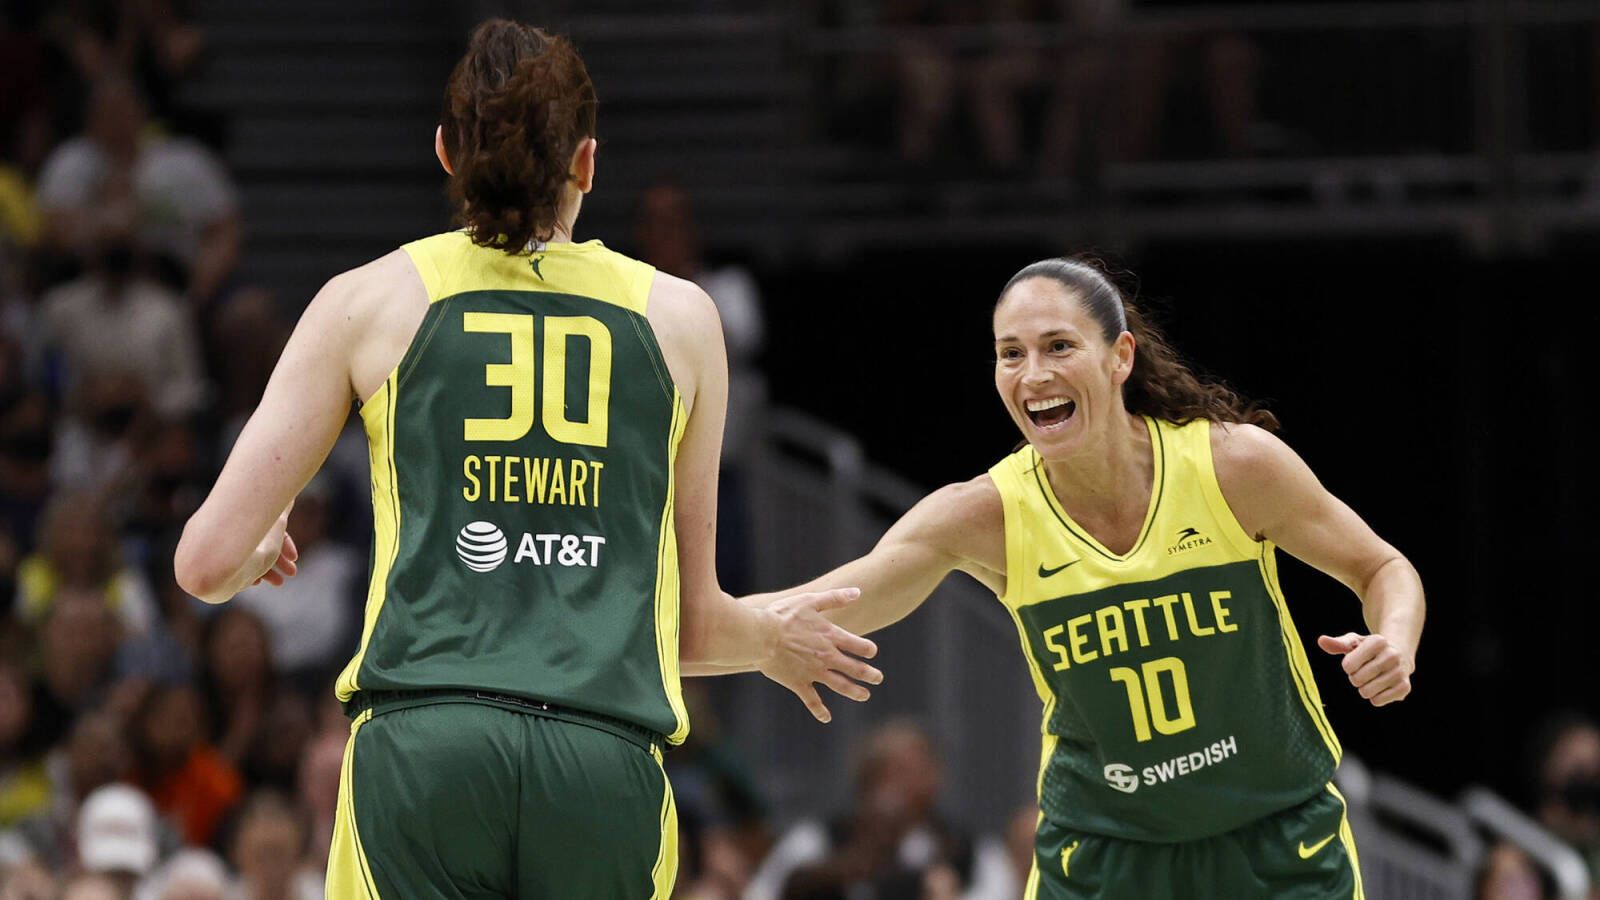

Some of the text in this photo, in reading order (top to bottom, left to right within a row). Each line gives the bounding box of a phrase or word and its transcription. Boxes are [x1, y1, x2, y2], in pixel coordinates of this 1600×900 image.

[463, 312, 612, 448] 30
[463, 454, 604, 508] STEWART
[513, 532, 606, 568] AT&T
[1167, 536, 1213, 556] SYMETRA
[1043, 590, 1239, 672] SEATTLE
[1109, 656, 1196, 743] 10
[1142, 735, 1238, 786] SWEDISH
